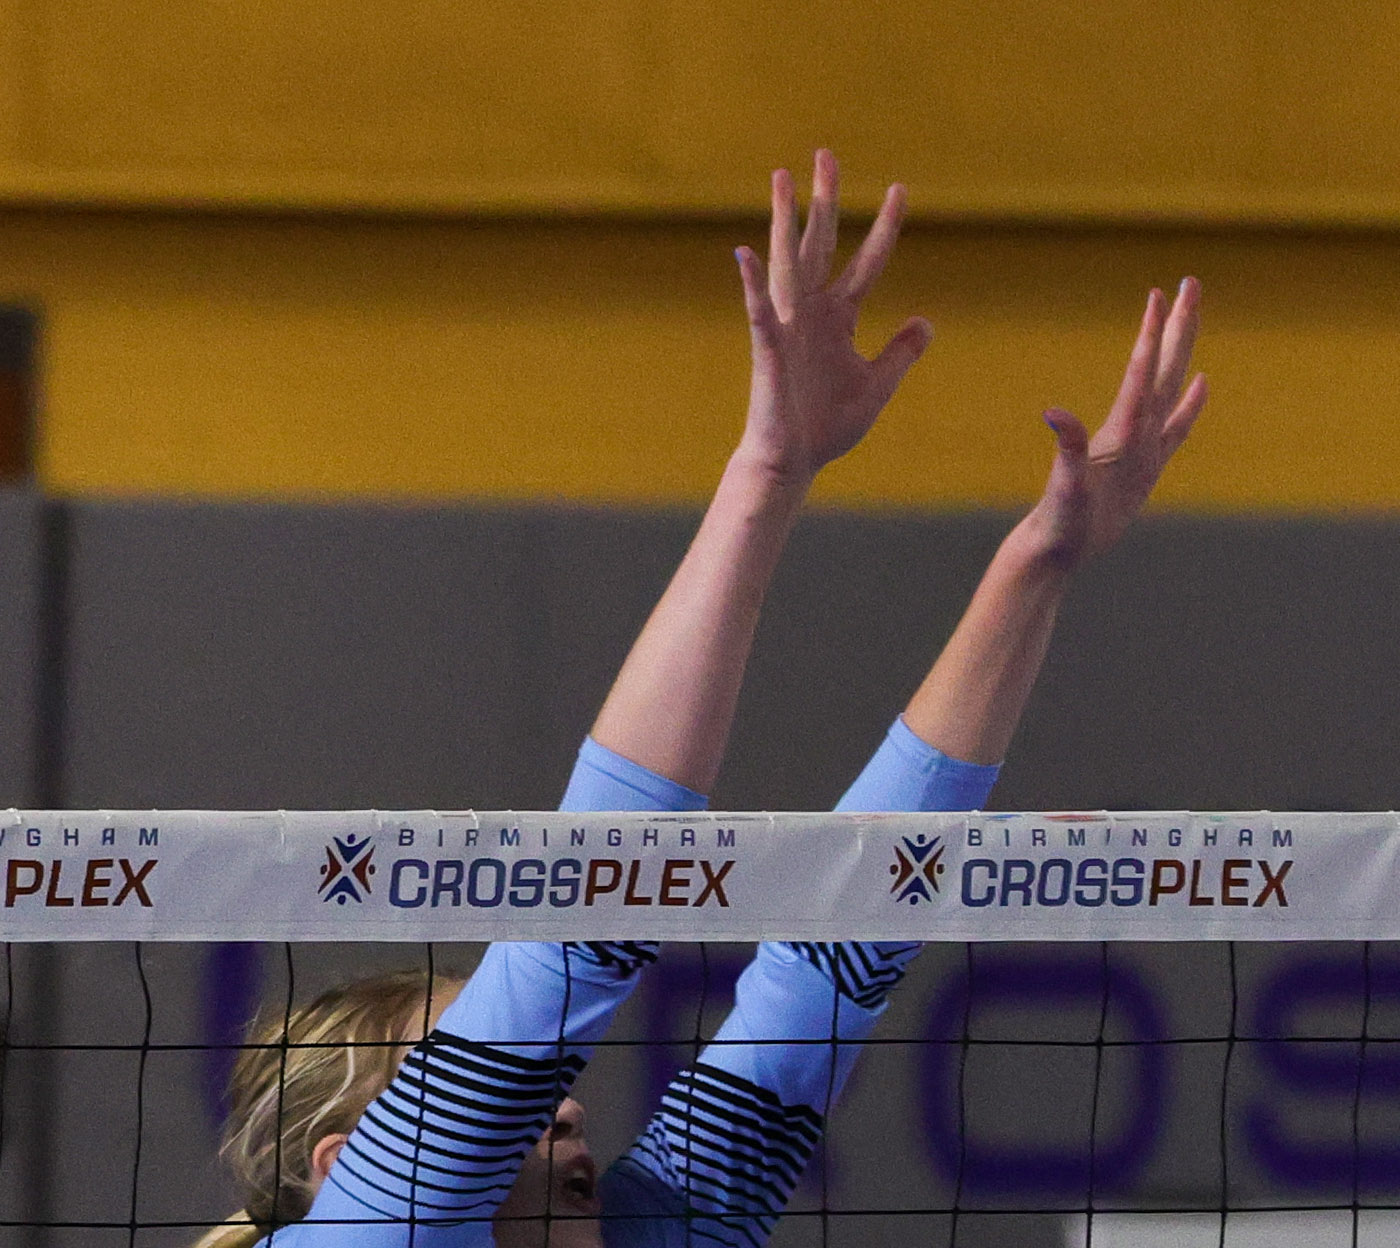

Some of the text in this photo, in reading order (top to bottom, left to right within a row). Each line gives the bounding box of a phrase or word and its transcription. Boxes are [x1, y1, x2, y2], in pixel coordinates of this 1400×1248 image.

[0, 828, 159, 847] GHAM
[397, 827, 736, 848] BIRMINGHAM
[967, 827, 1293, 848] BIRMINGHAM
[389, 857, 735, 908] CROSSPLEX
[961, 857, 1294, 908] CROSSPLEX
